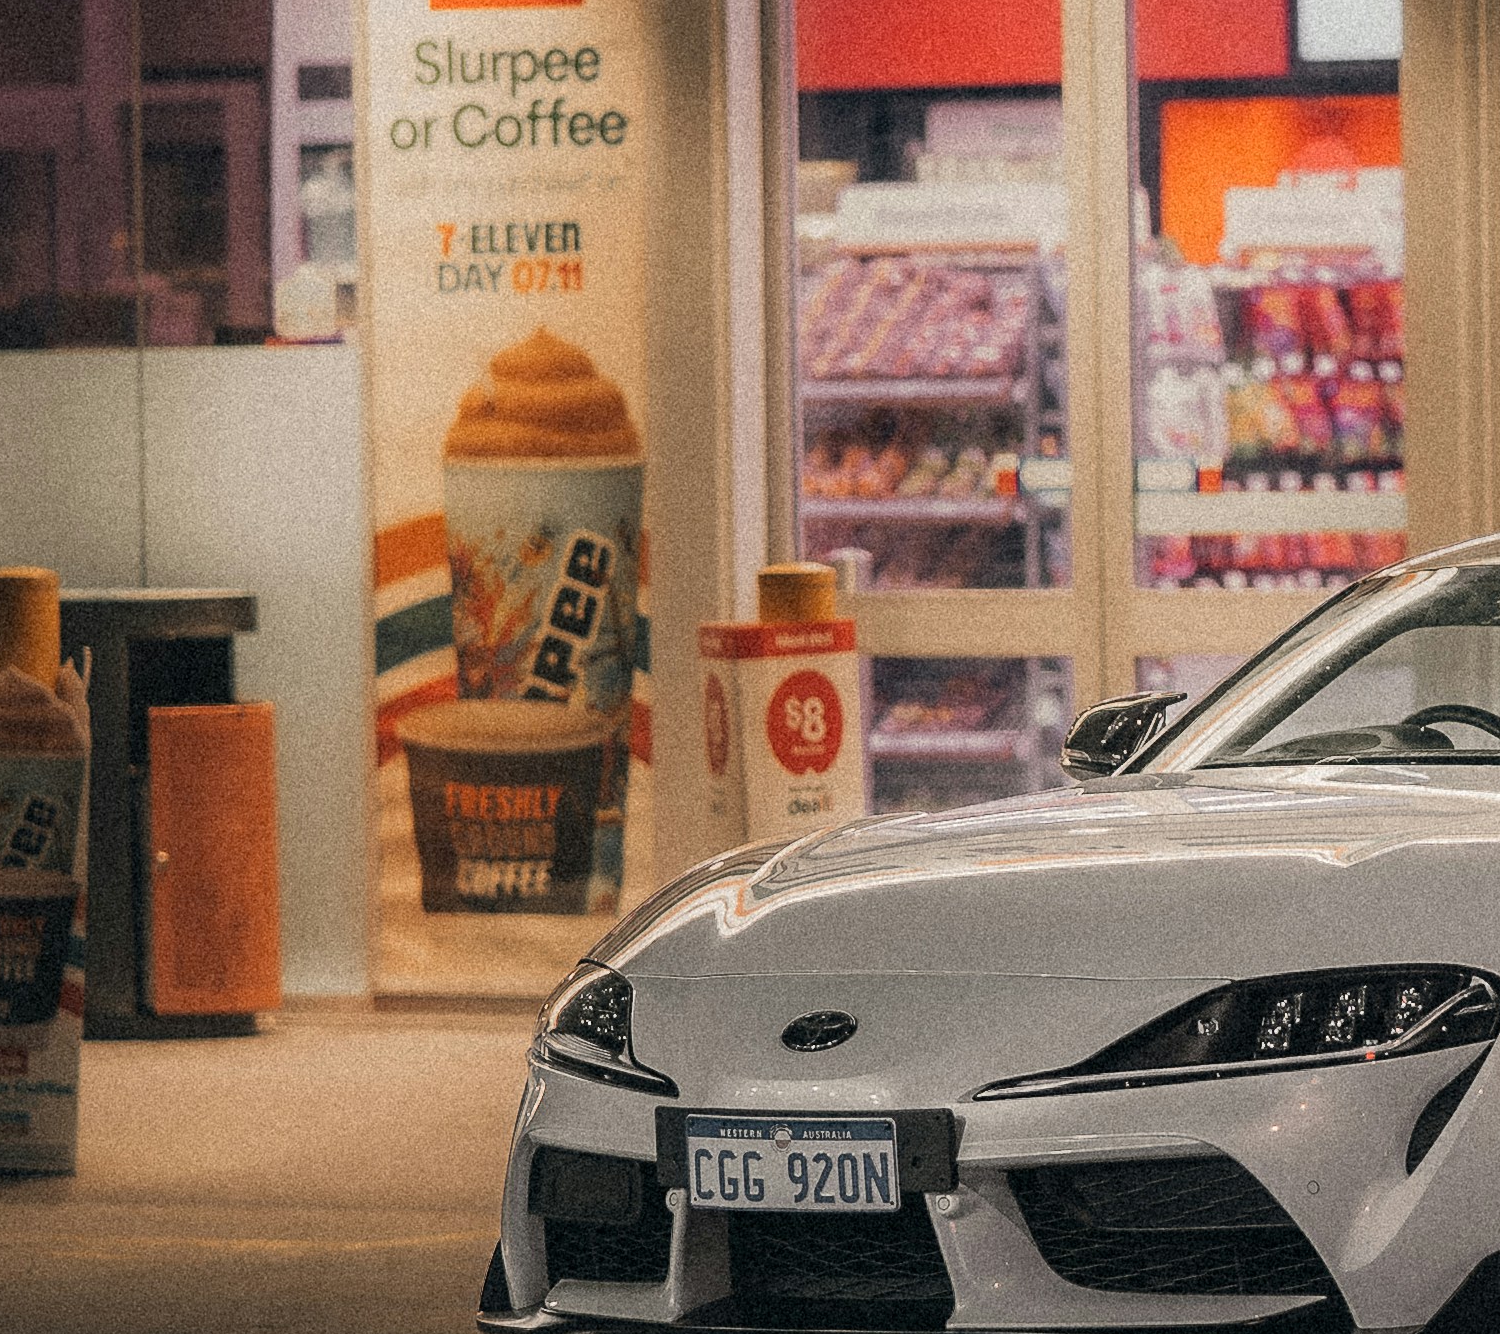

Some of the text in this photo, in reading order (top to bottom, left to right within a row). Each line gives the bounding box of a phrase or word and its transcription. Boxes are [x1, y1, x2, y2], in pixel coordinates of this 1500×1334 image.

[415, 41, 601, 98] Slurpee
[390, 99, 628, 151] or Coffee
[438, 261, 501, 294] DAY
[784, 696, 827, 744] $8
[445, 781, 562, 820] FRESHLY
[719, 1128, 853, 1140] WESTERN AUSTRALIA
[694, 1148, 765, 1202] CGG
